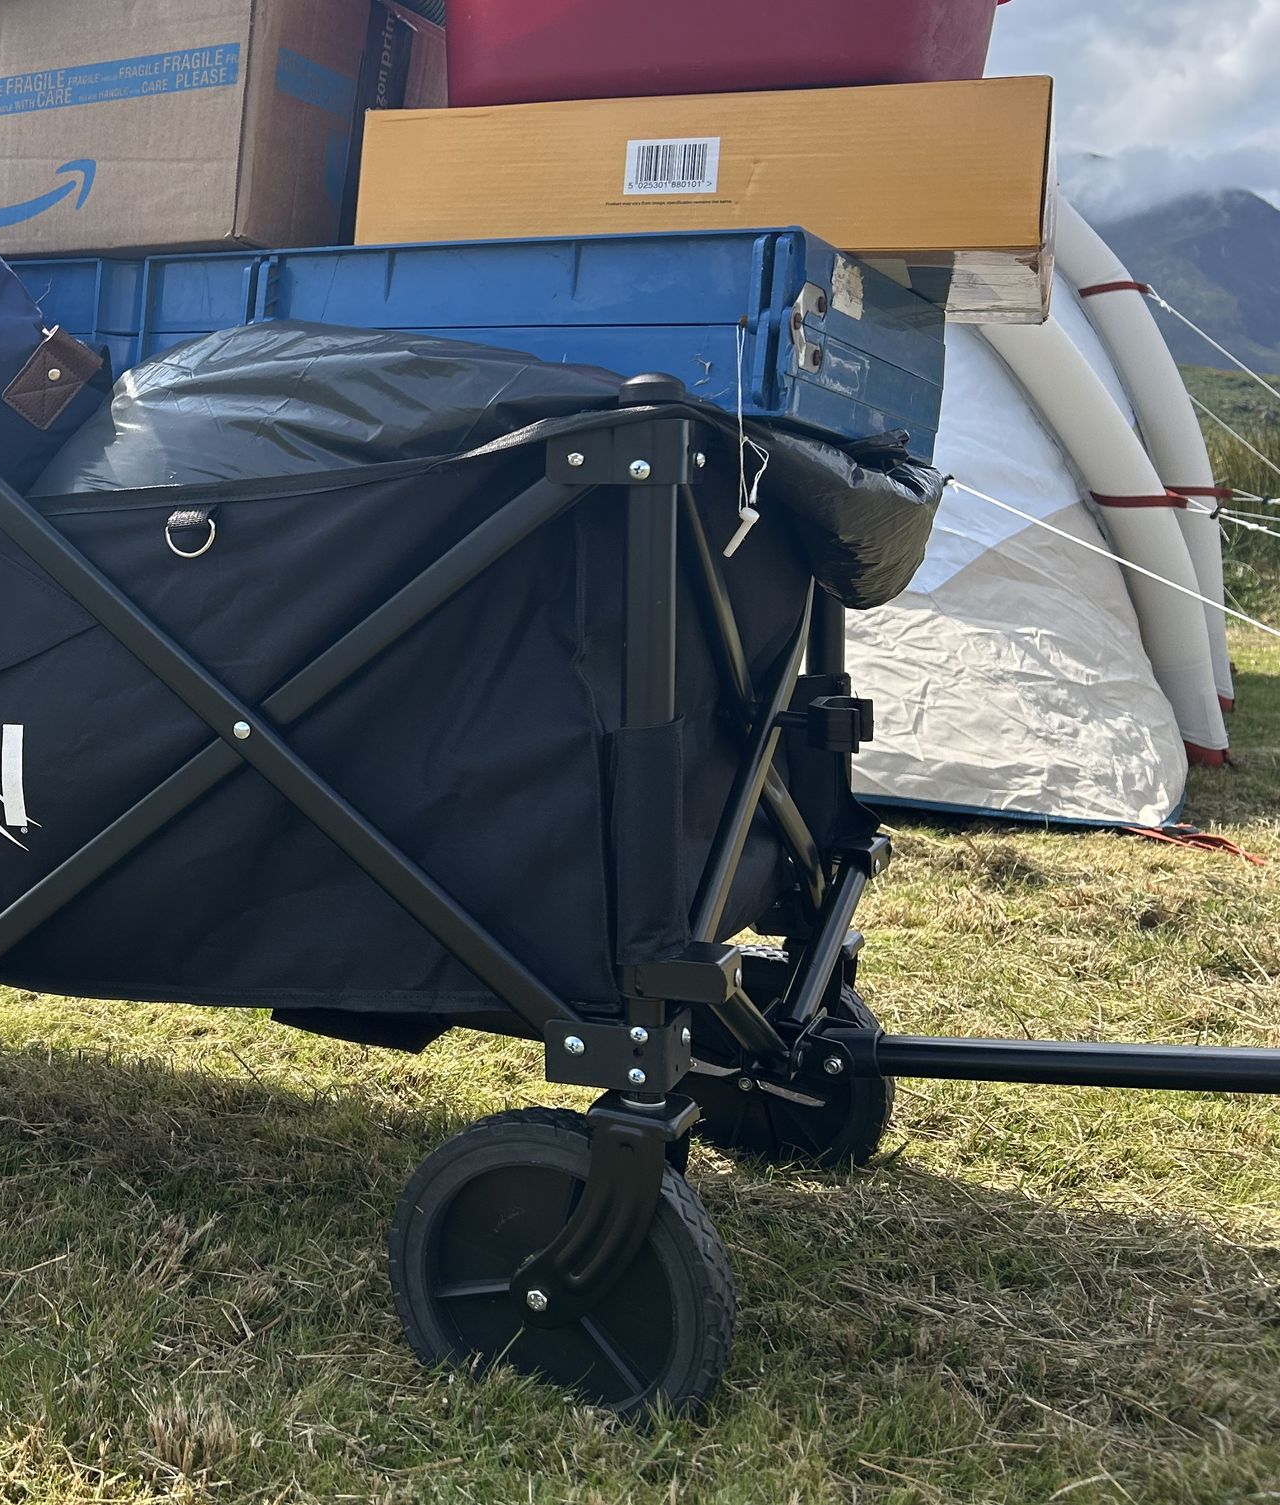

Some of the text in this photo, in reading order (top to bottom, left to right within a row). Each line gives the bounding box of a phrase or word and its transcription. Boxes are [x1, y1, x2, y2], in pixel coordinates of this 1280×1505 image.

[6, 70, 65, 96] FRAGILE
[68, 73, 100, 87] FRAGILE
[119, 62, 160, 79] FRAGILE
[163, 49, 224, 73] FRAGILE
[15, 99, 35, 110] WITH
[37, 87, 73, 108] CARE
[98, 87, 129, 99] HANDLE
[142, 79, 169, 94] CARE
[175, 67, 228, 88] PLEASE
[638, 181, 668, 189] 025301
